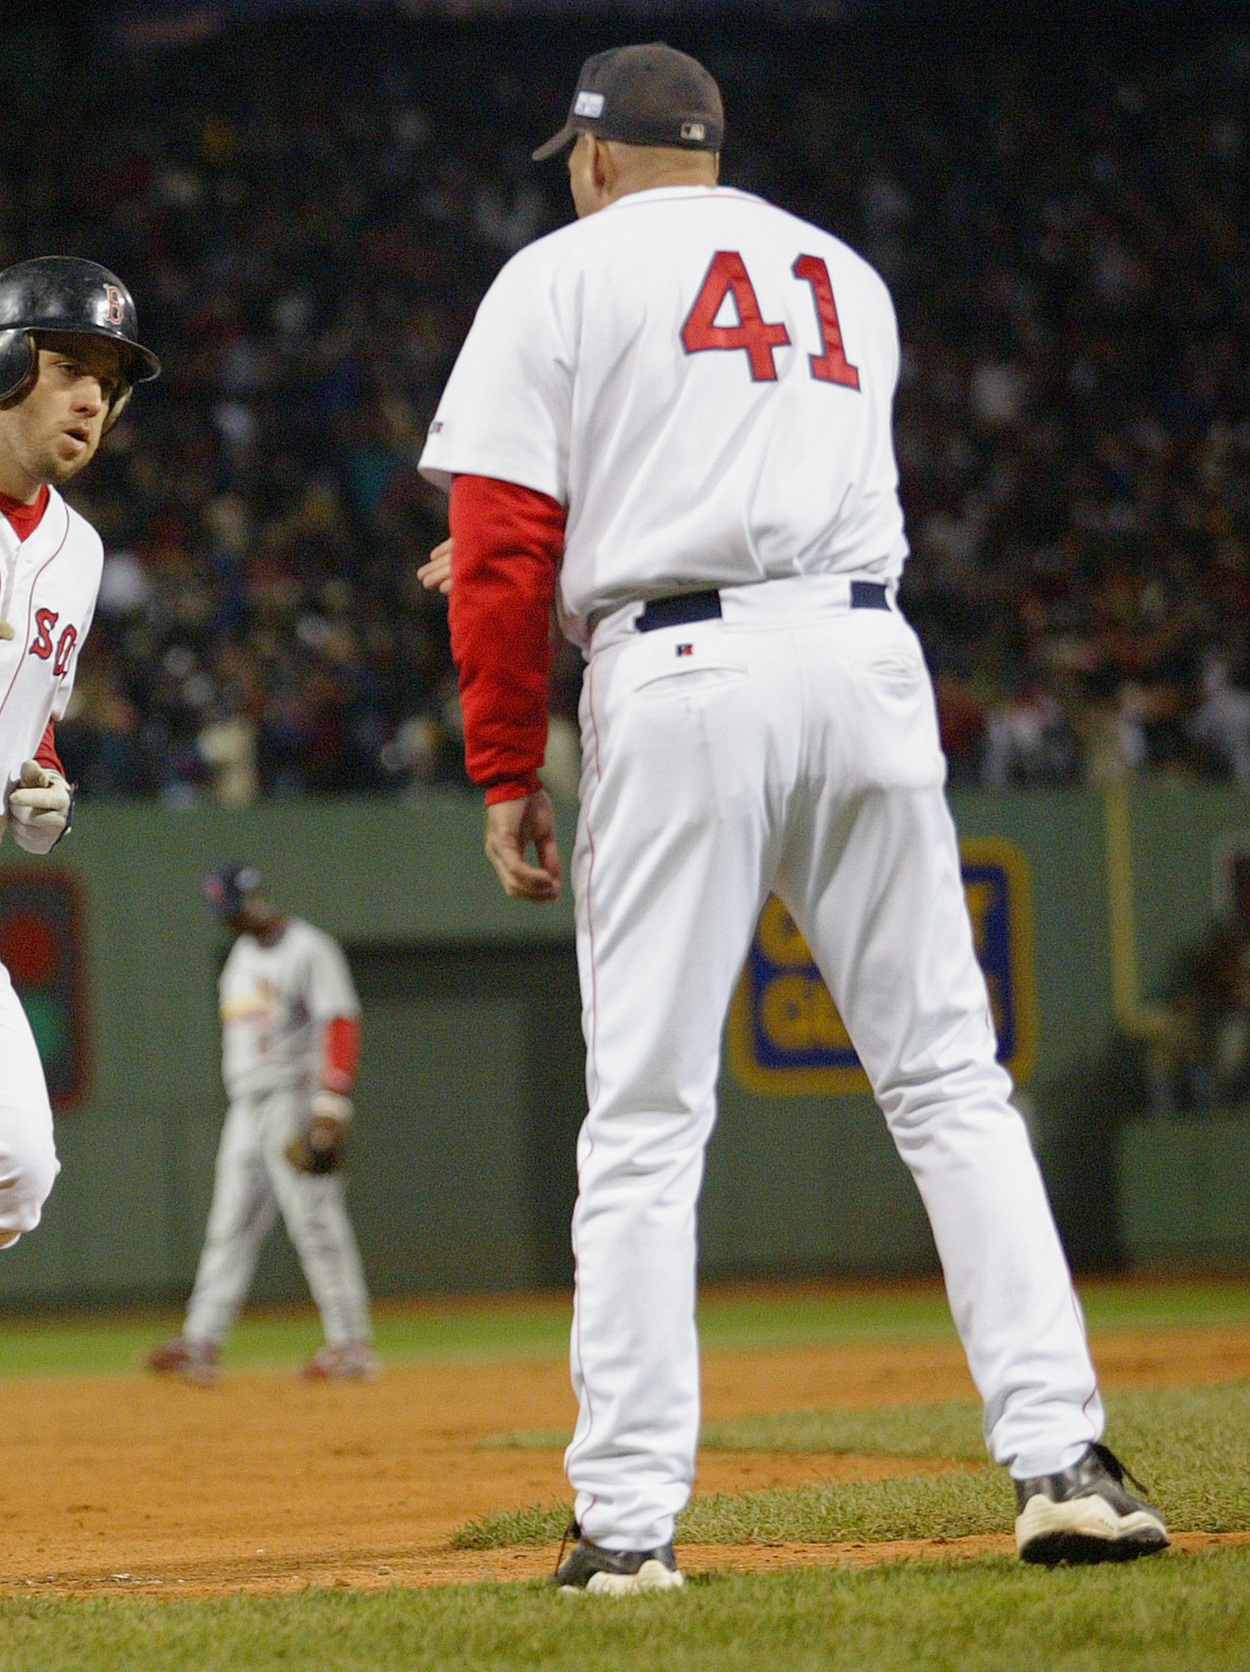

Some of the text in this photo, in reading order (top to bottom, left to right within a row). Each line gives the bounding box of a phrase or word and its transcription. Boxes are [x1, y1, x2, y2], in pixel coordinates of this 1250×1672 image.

[103, 283, 125, 326] B
[680, 249, 861, 393] 41
[29, 608, 77, 681] SO
